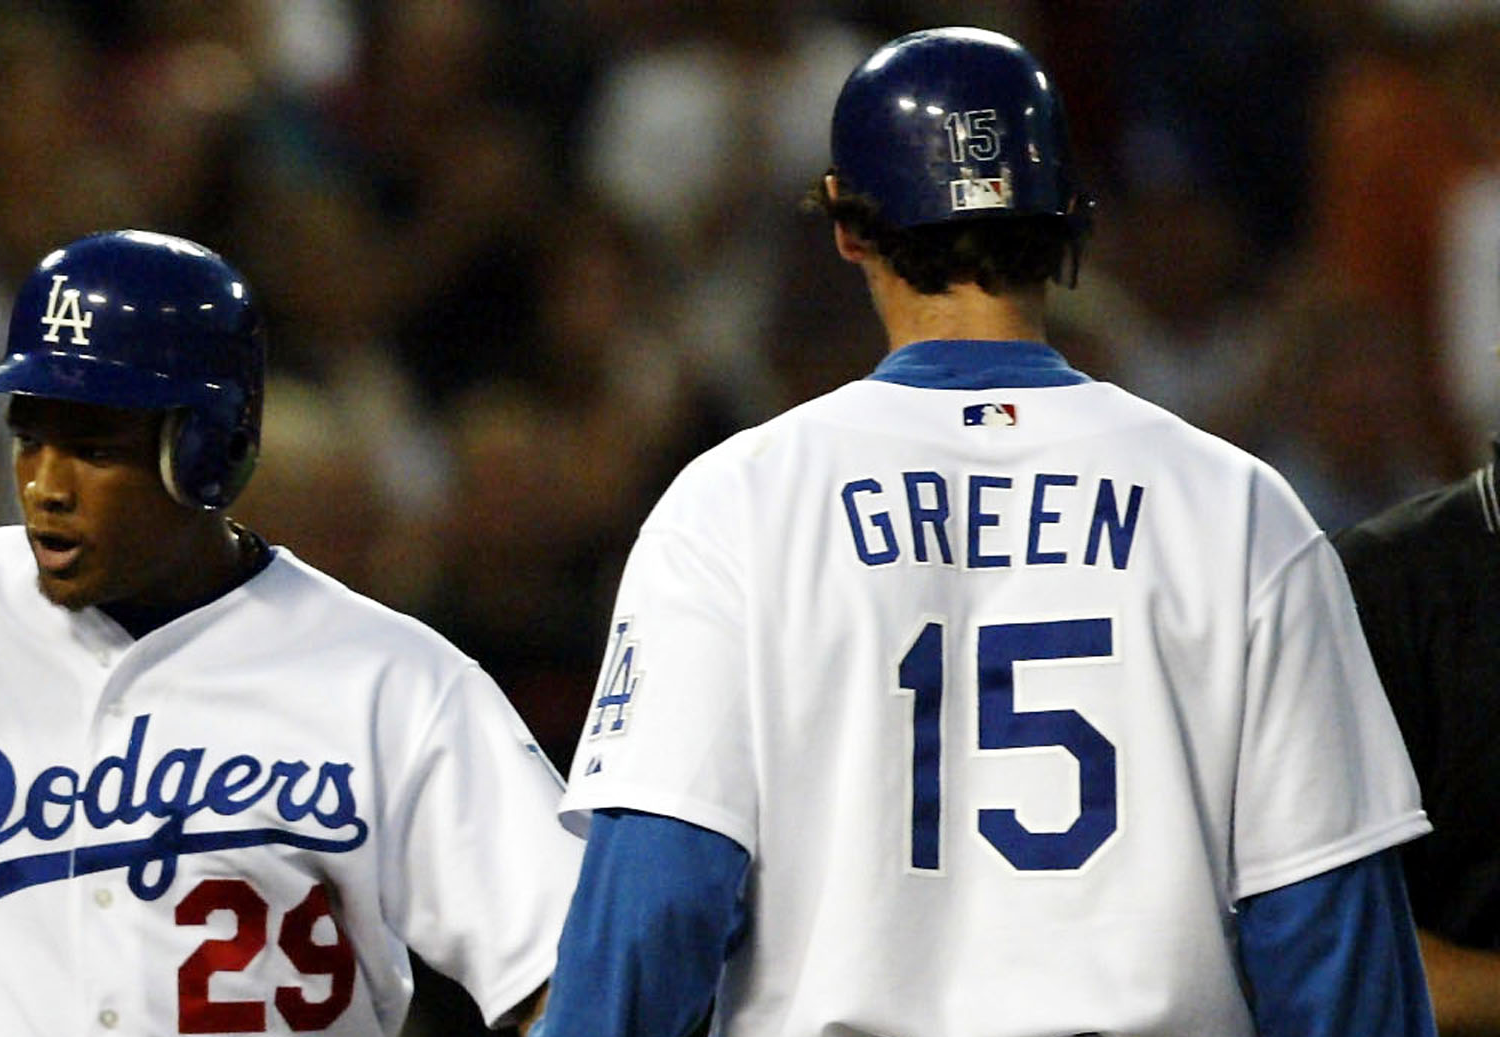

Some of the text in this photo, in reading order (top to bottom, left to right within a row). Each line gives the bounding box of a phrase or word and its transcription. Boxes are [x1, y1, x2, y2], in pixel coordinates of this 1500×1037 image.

[943, 108, 1001, 163] 15
[41, 275, 94, 346] LA
[841, 471, 1145, 570] GREEN
[899, 617, 1118, 871] 15
[174, 879, 356, 1035] 29
